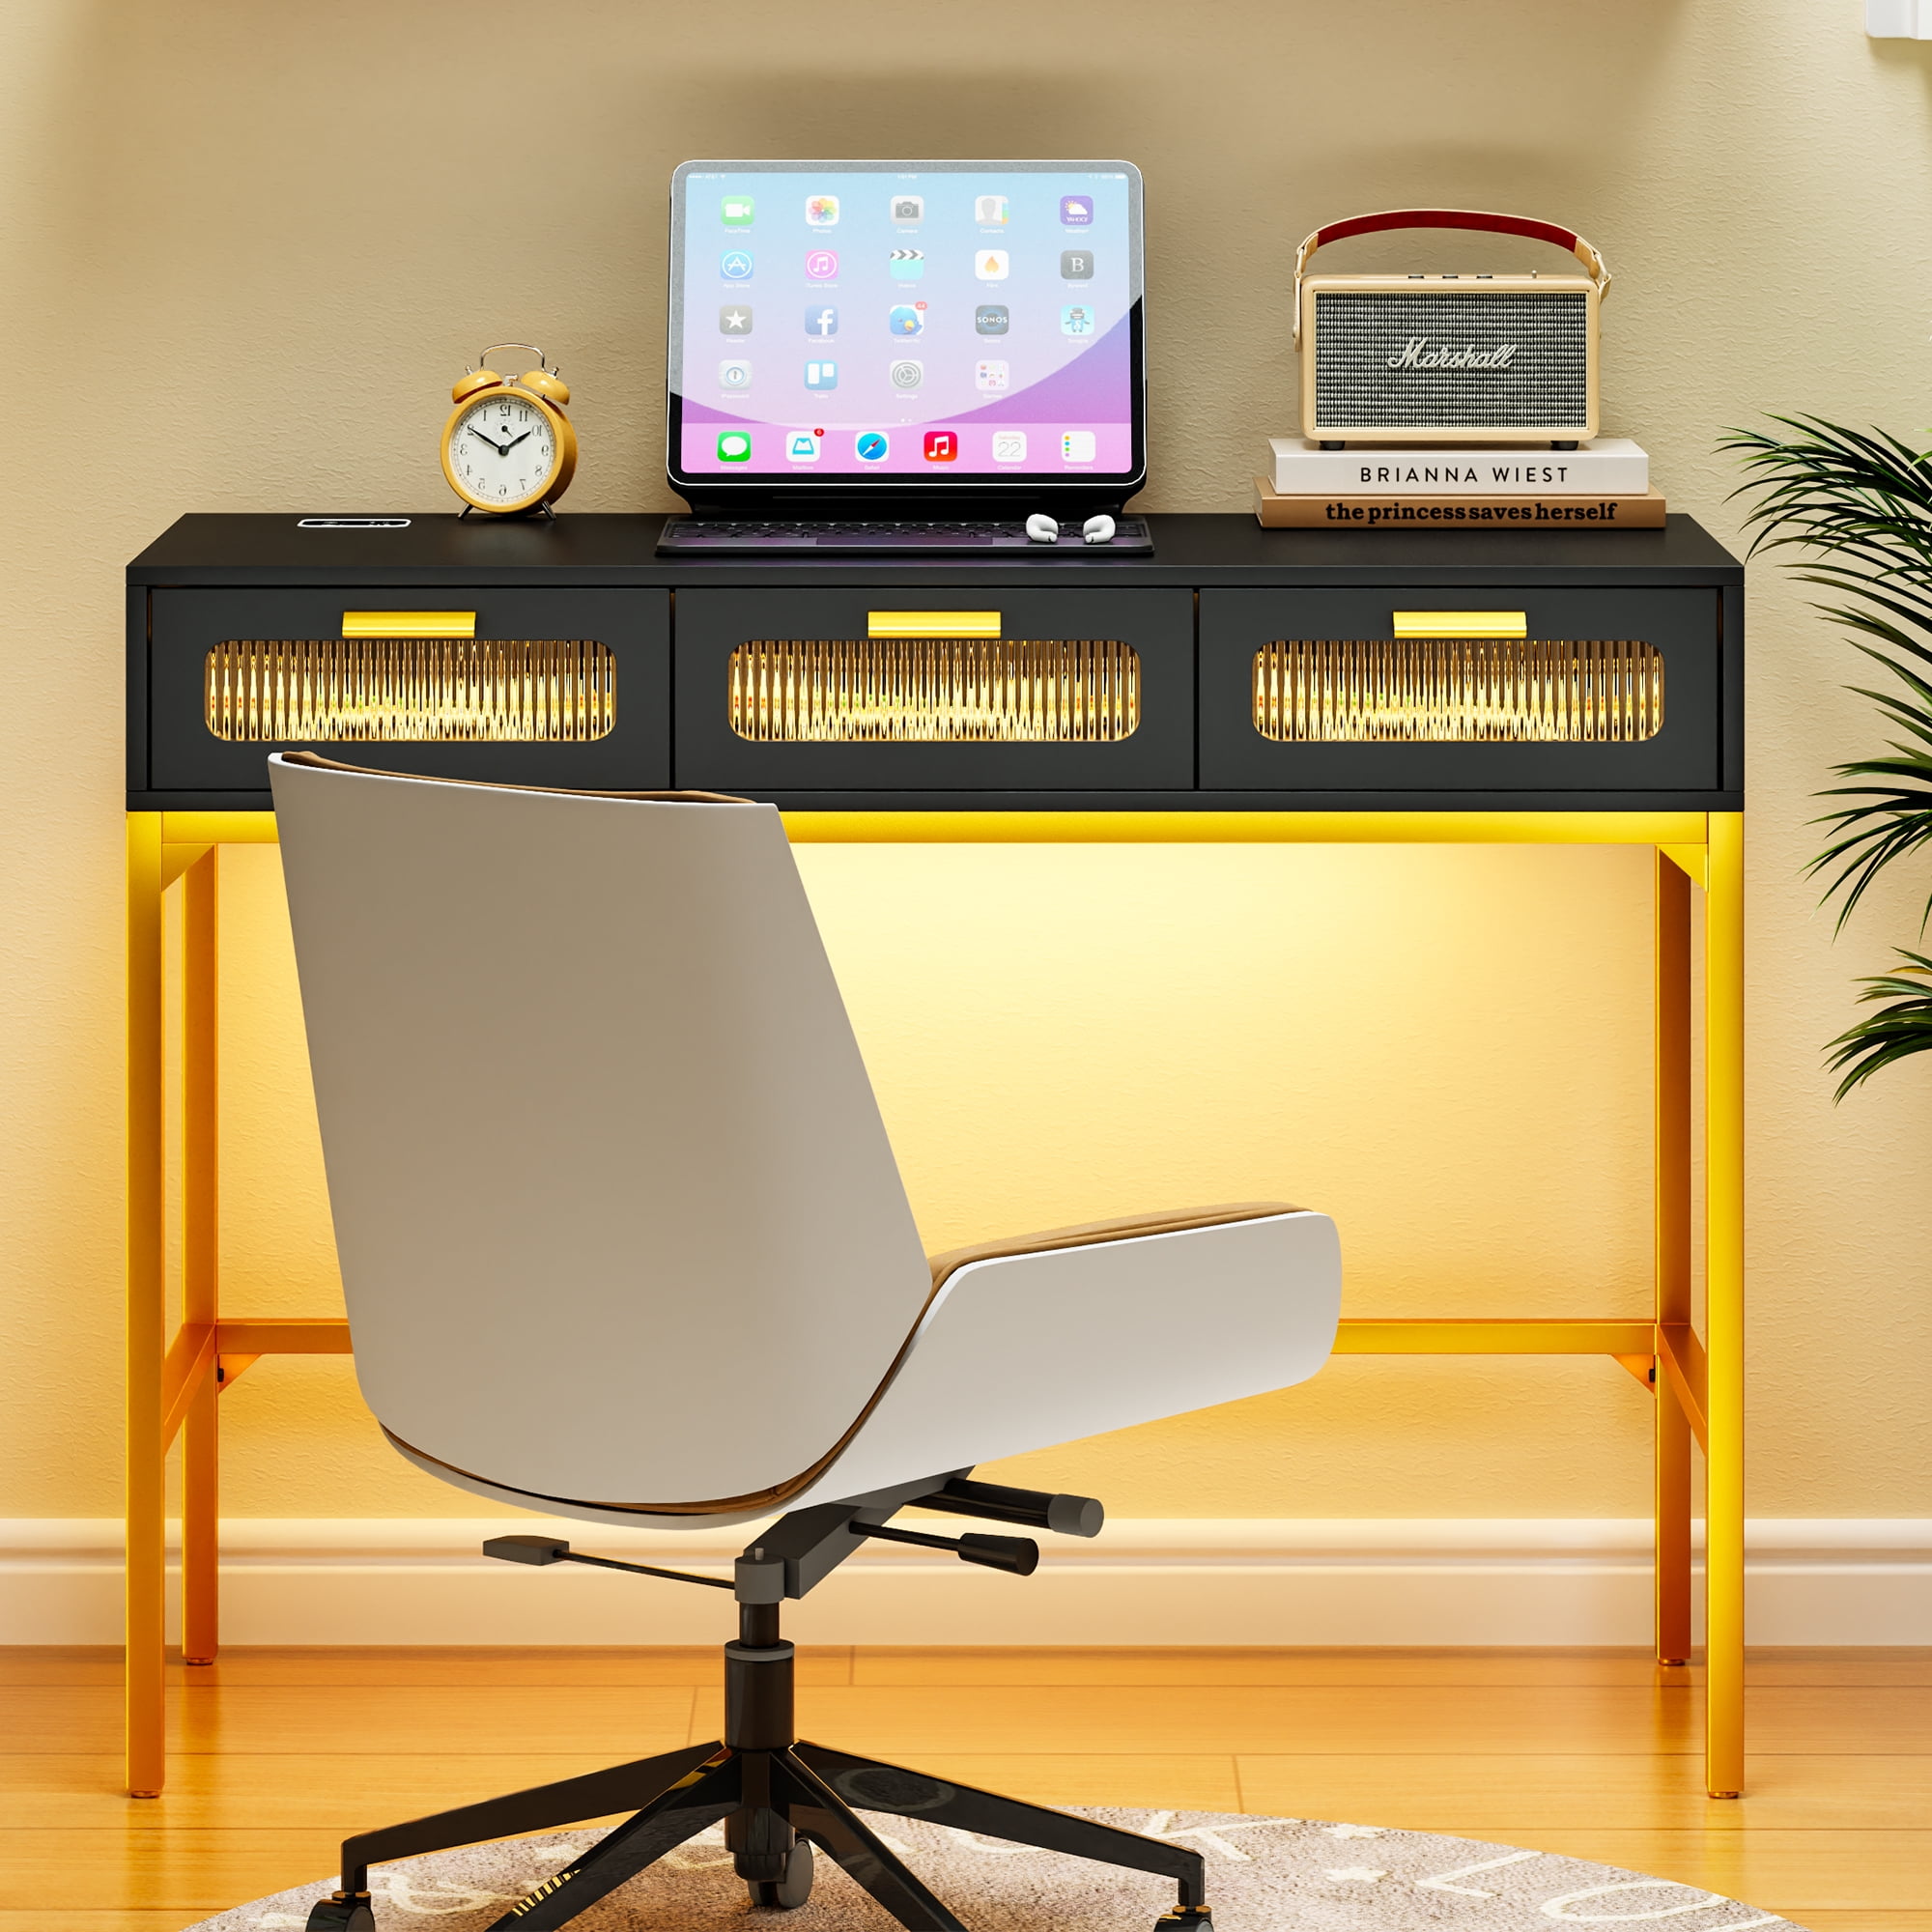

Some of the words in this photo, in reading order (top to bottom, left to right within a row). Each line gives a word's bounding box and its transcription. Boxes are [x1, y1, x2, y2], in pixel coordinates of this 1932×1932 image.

[1070, 257, 1084, 272] B
[817, 308, 834, 335] f
[1387, 337, 1518, 369] Marshall
[998, 441, 1021, 457] 22
[1360, 467, 1478, 482] BRIANNA
[1492, 467, 1568, 482] WIEST
[1325, 502, 1365, 521] the
[1367, 502, 1466, 525] princess
[1468, 506, 1532, 521] saves
[1534, 502, 1618, 521] herself
